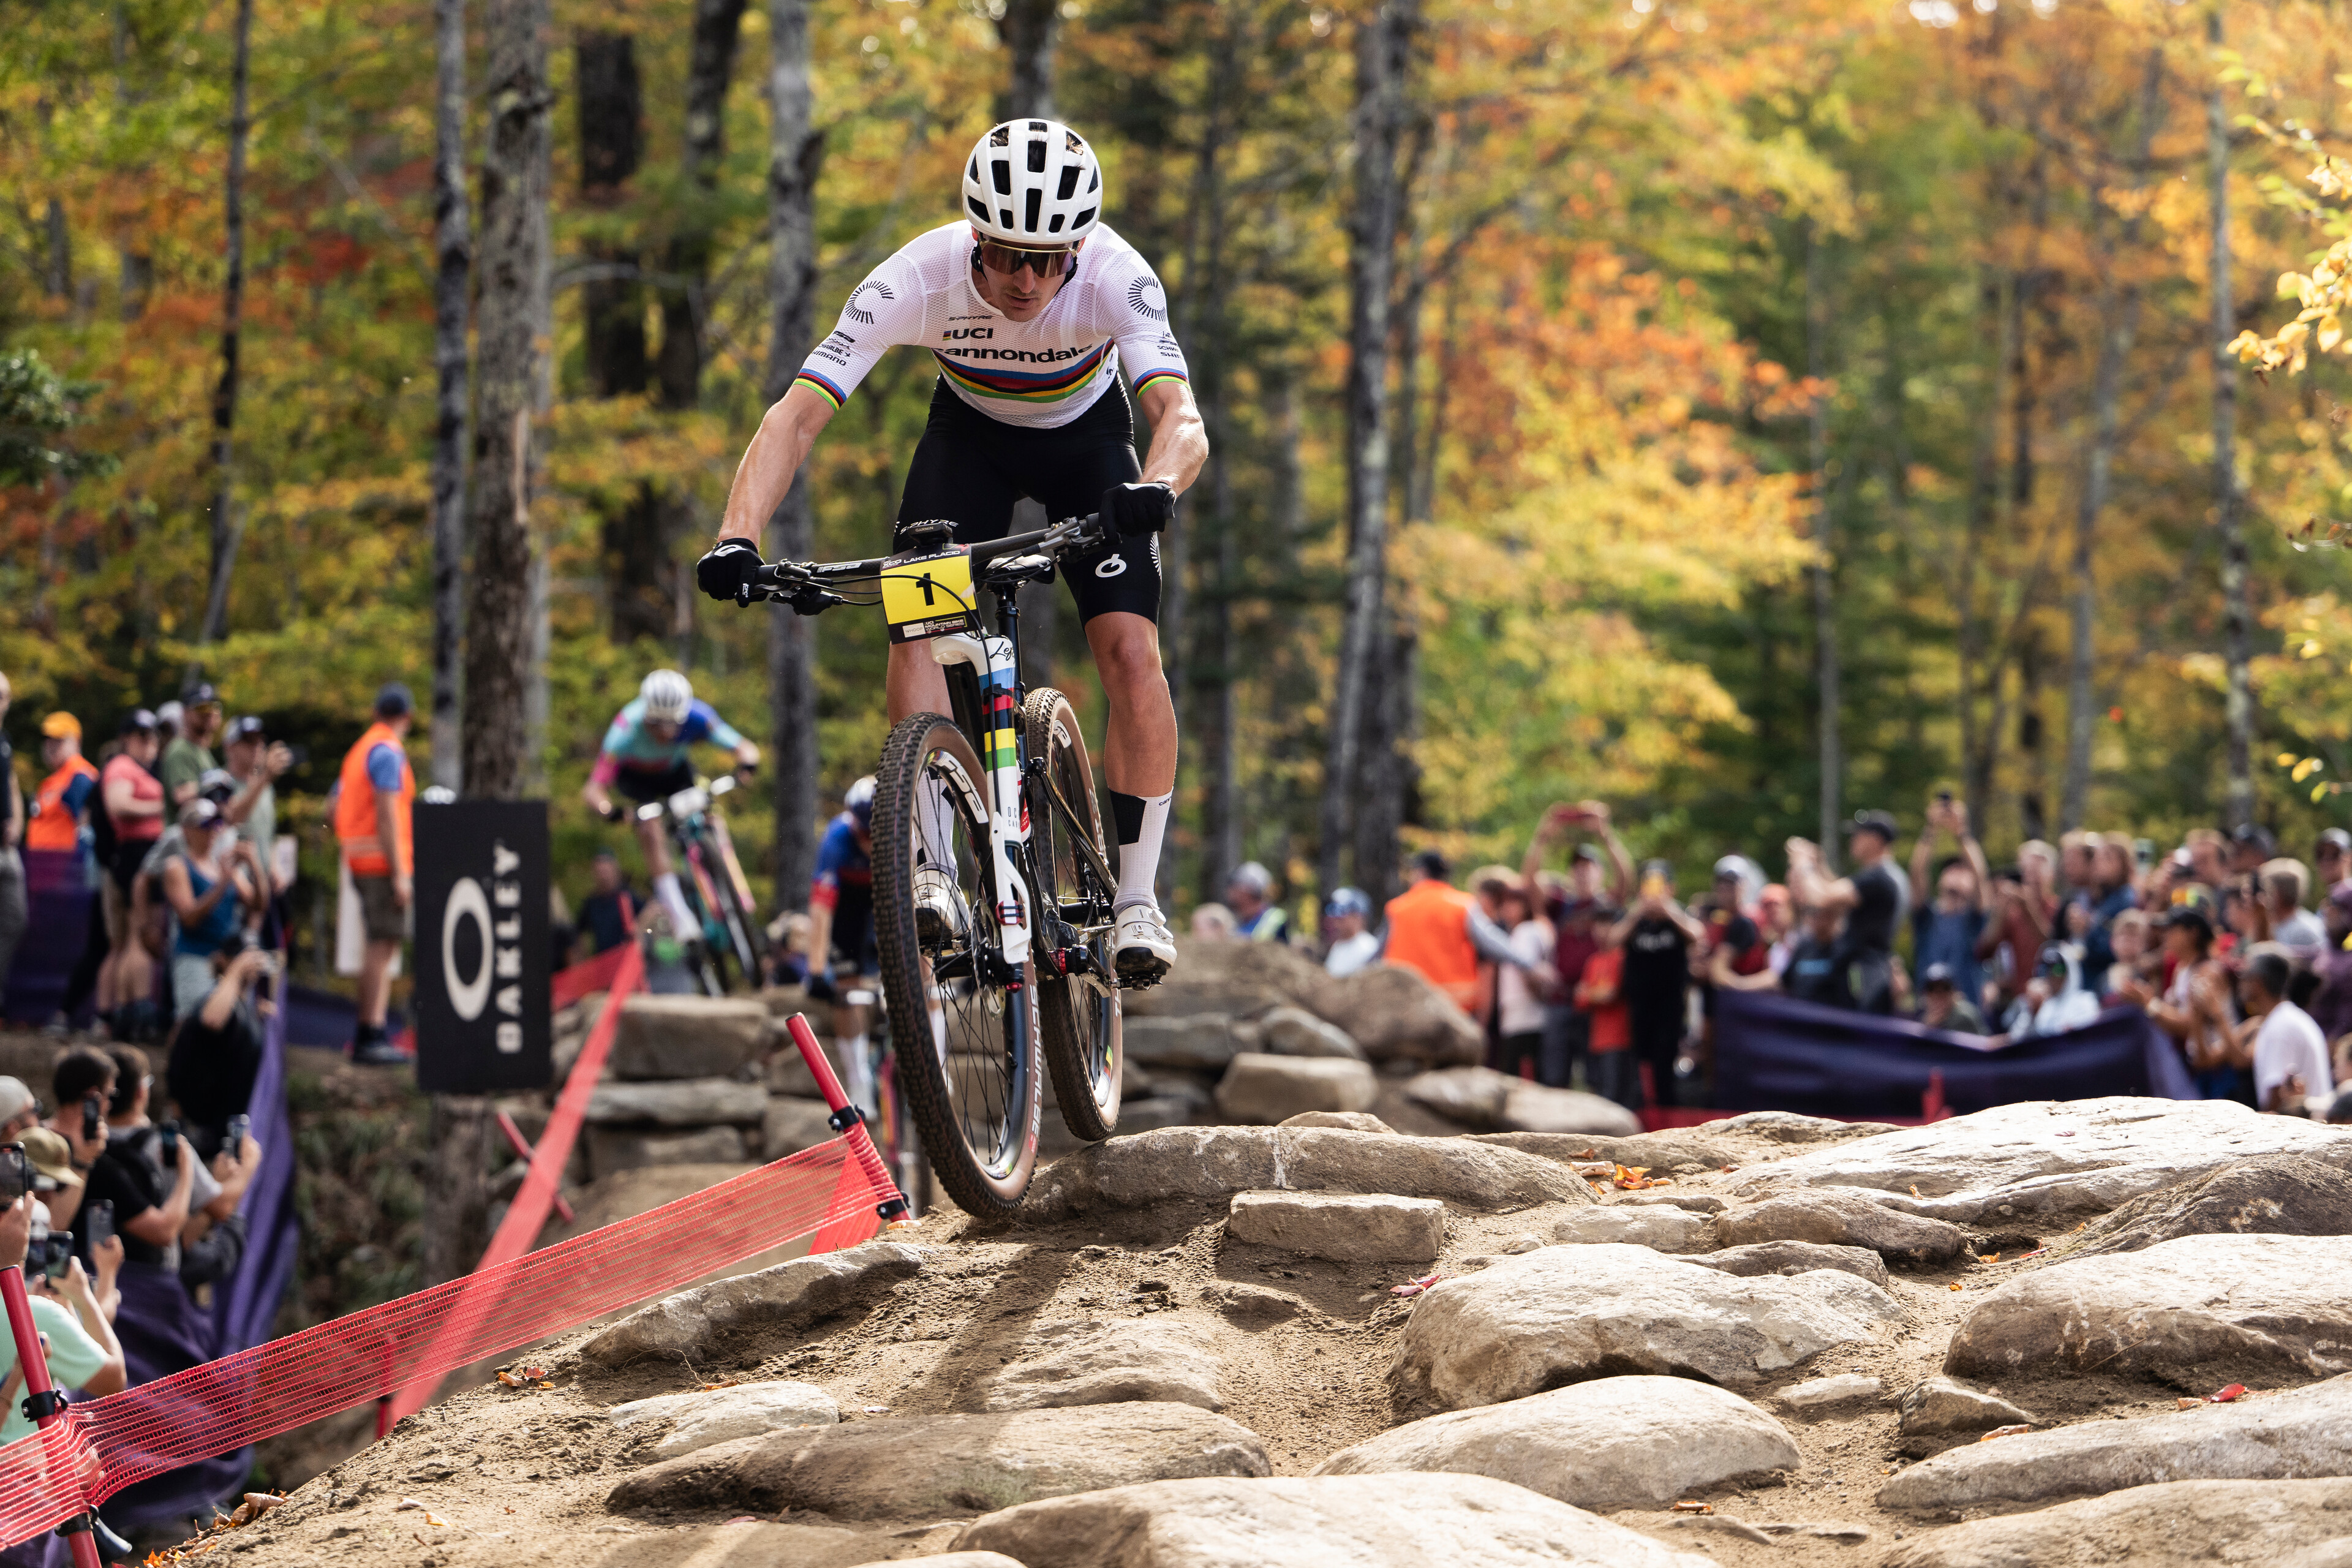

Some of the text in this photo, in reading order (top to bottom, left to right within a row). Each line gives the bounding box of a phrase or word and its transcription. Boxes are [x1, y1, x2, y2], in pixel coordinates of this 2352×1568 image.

[952, 328, 993, 339] UCI
[932, 344, 1093, 363] cannondale
[903, 555, 927, 564] LAKE
[929, 550, 960, 559] PLACID
[916, 572, 935, 606] 1
[493, 837, 523, 1054] OAKLEY
[1028, 984, 1041, 1138] SCHWALBE
